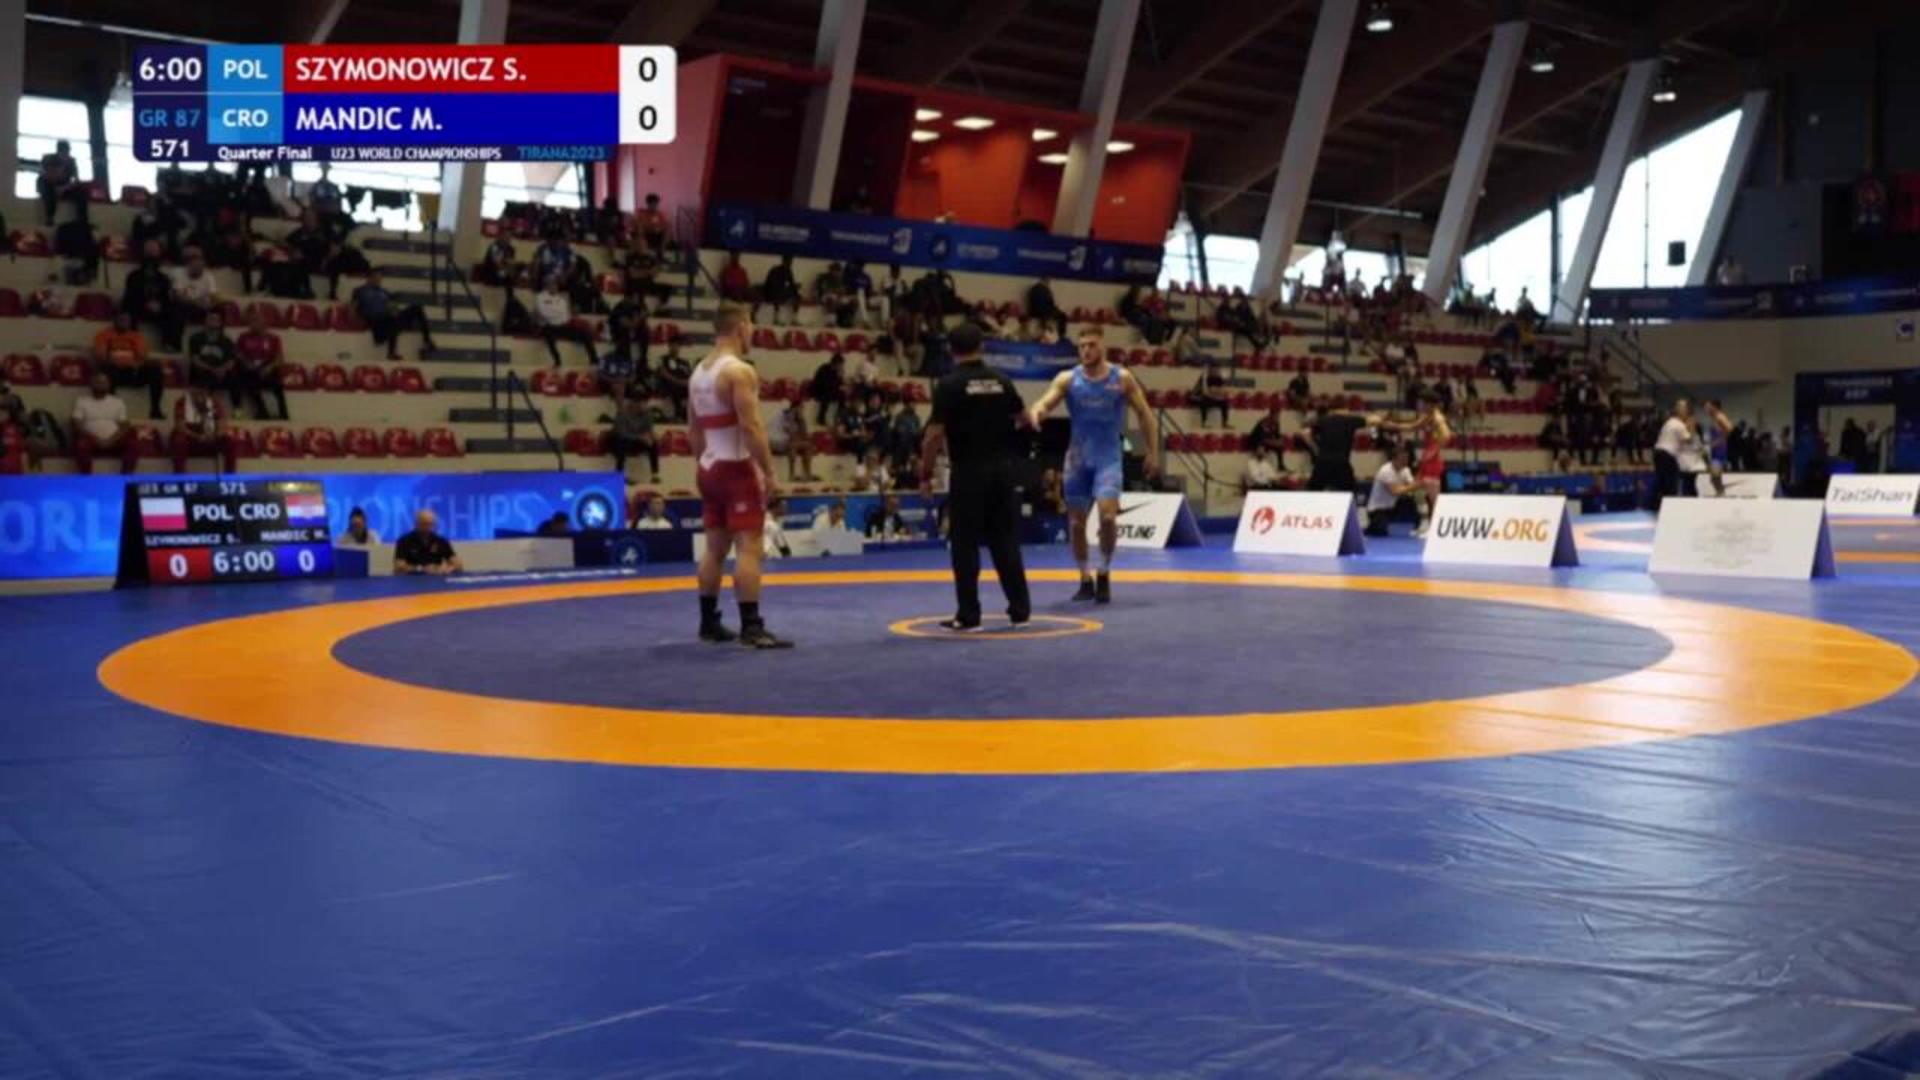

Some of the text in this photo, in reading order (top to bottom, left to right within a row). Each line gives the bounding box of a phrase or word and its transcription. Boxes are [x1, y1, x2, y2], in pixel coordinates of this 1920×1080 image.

[220, 482, 247, 496] 571
[192, 503, 281, 522] POL CRO
[1280, 515, 1334, 530] ATLAS
[1436, 516, 1552, 542] UWW.ORG
[169, 553, 188, 578] 0
[213, 551, 275, 574] 6:00
[297, 549, 315, 572] 0
